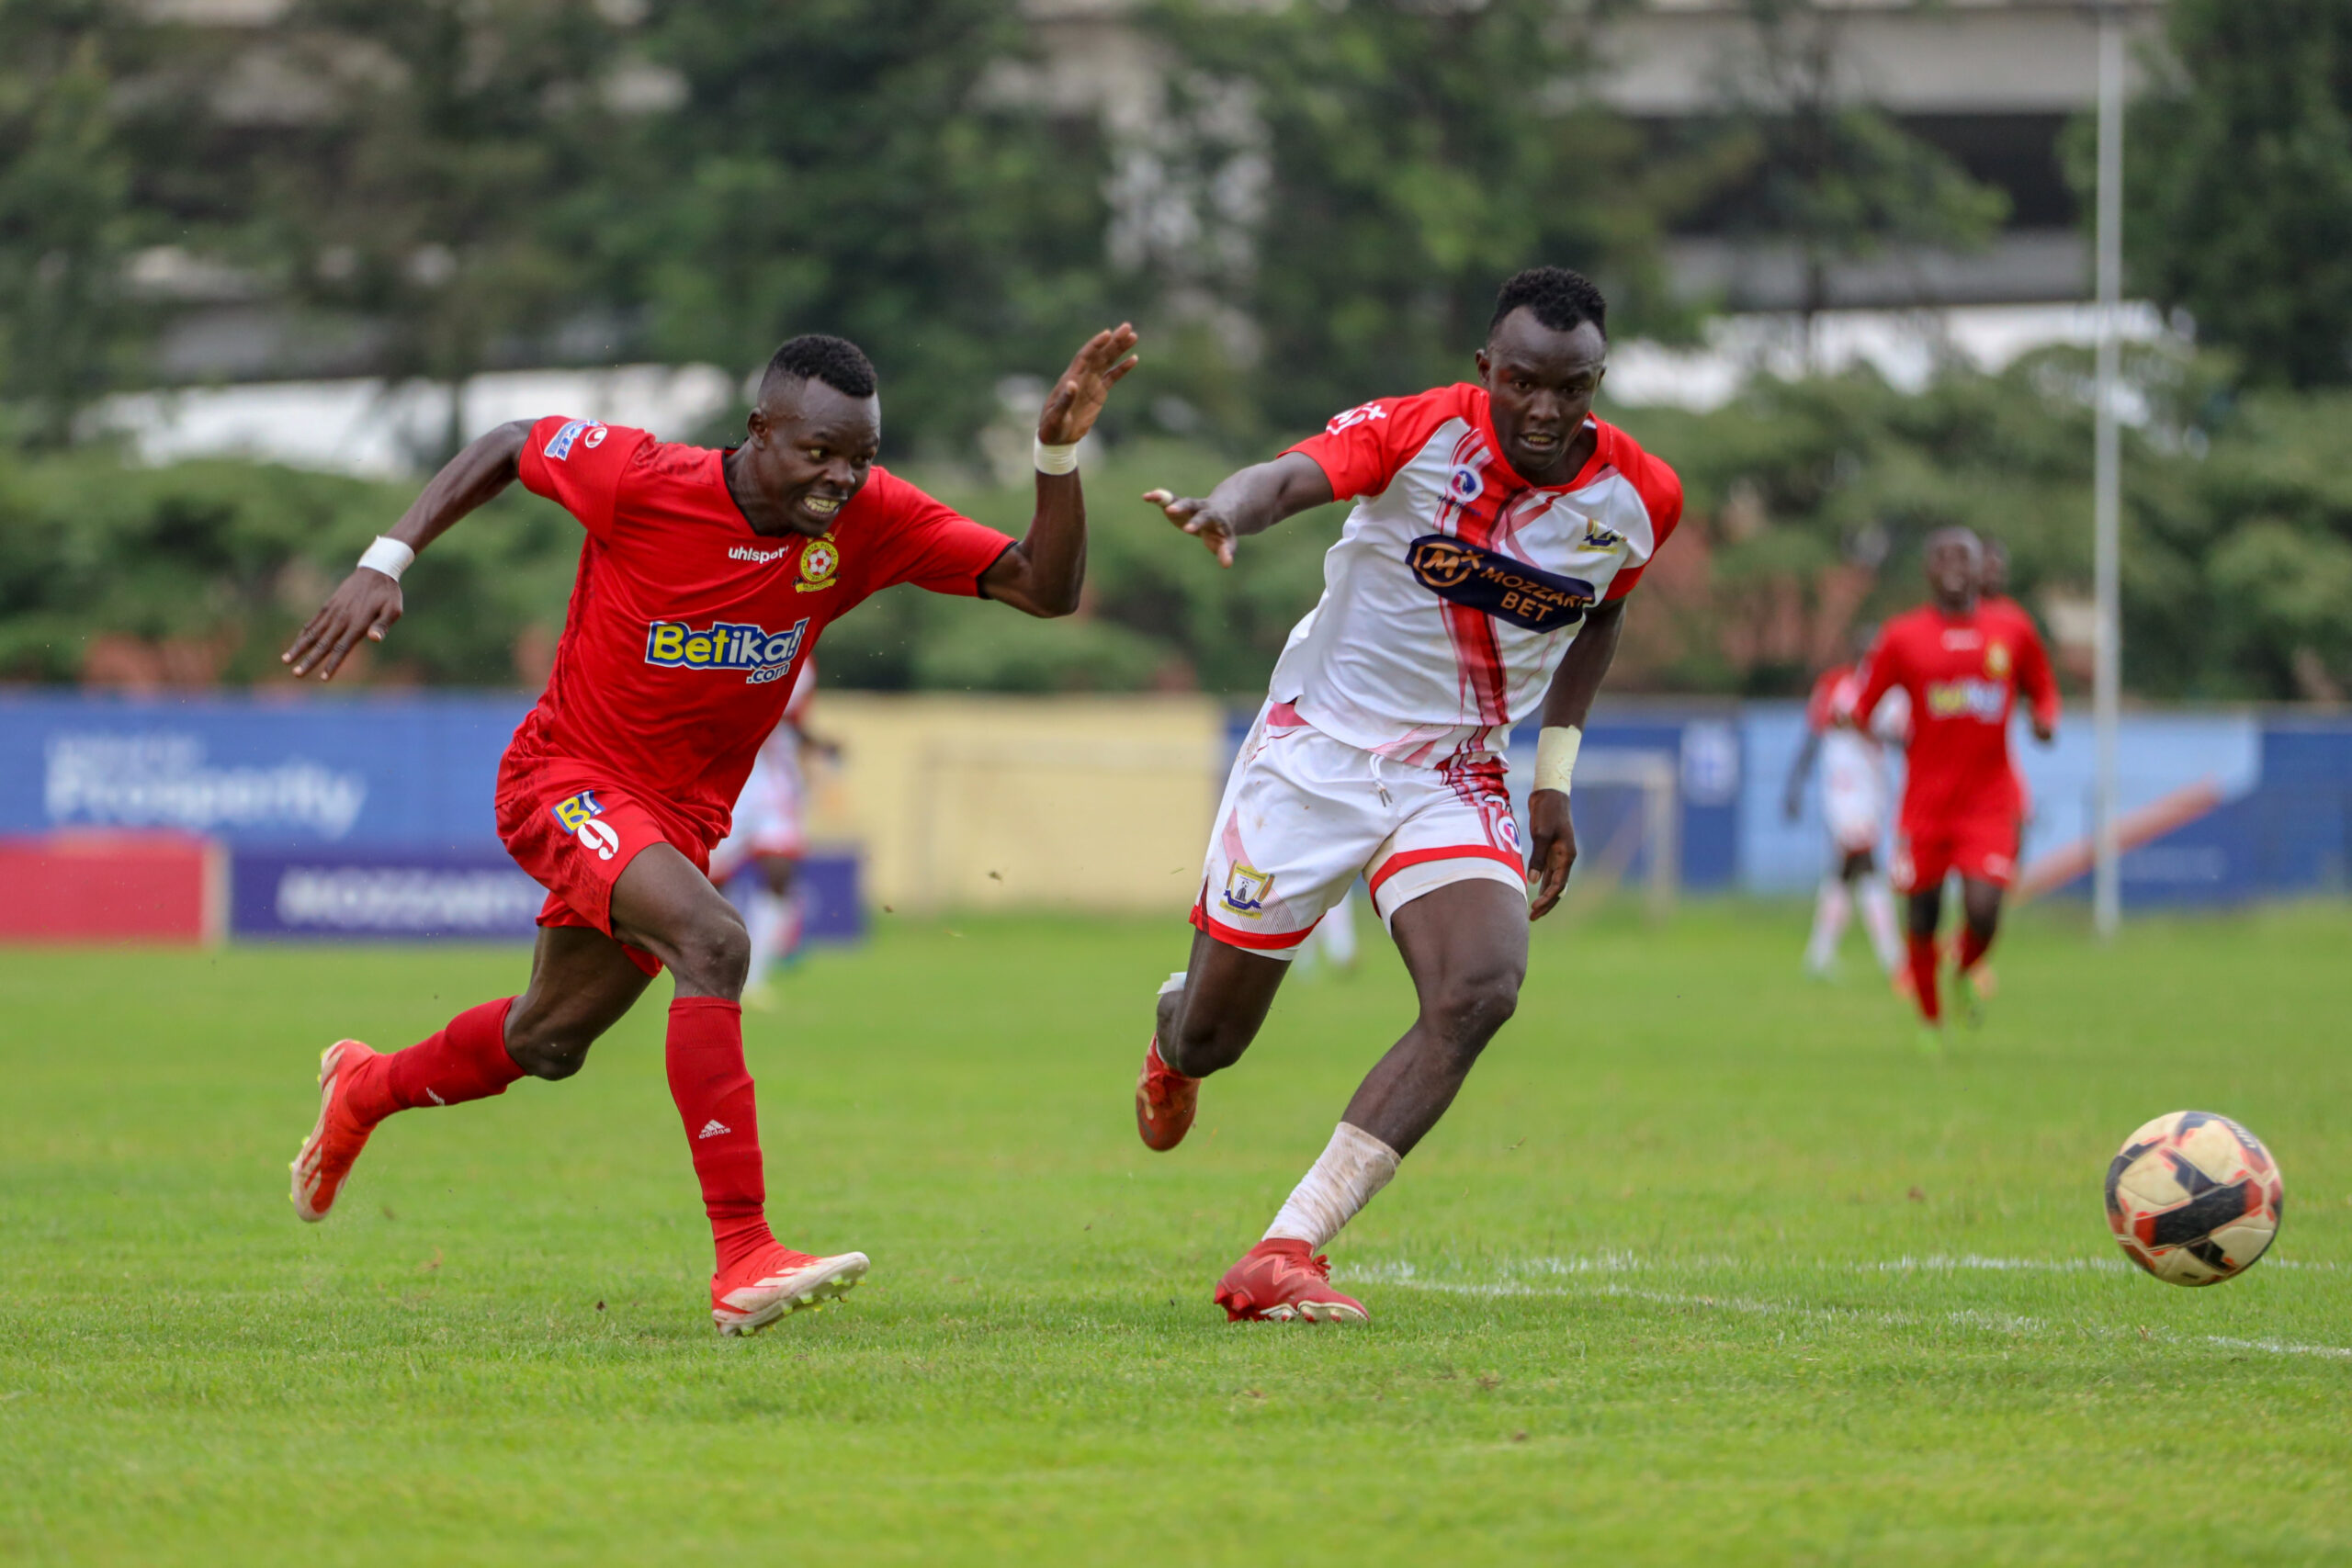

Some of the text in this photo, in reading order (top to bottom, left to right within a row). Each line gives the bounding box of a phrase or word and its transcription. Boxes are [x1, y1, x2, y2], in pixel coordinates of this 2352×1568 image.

[1500, 591, 1554, 622] BET
[747, 663, 788, 683] .com
[577, 818, 620, 861] 9
[698, 1127, 731, 1140] adidas
